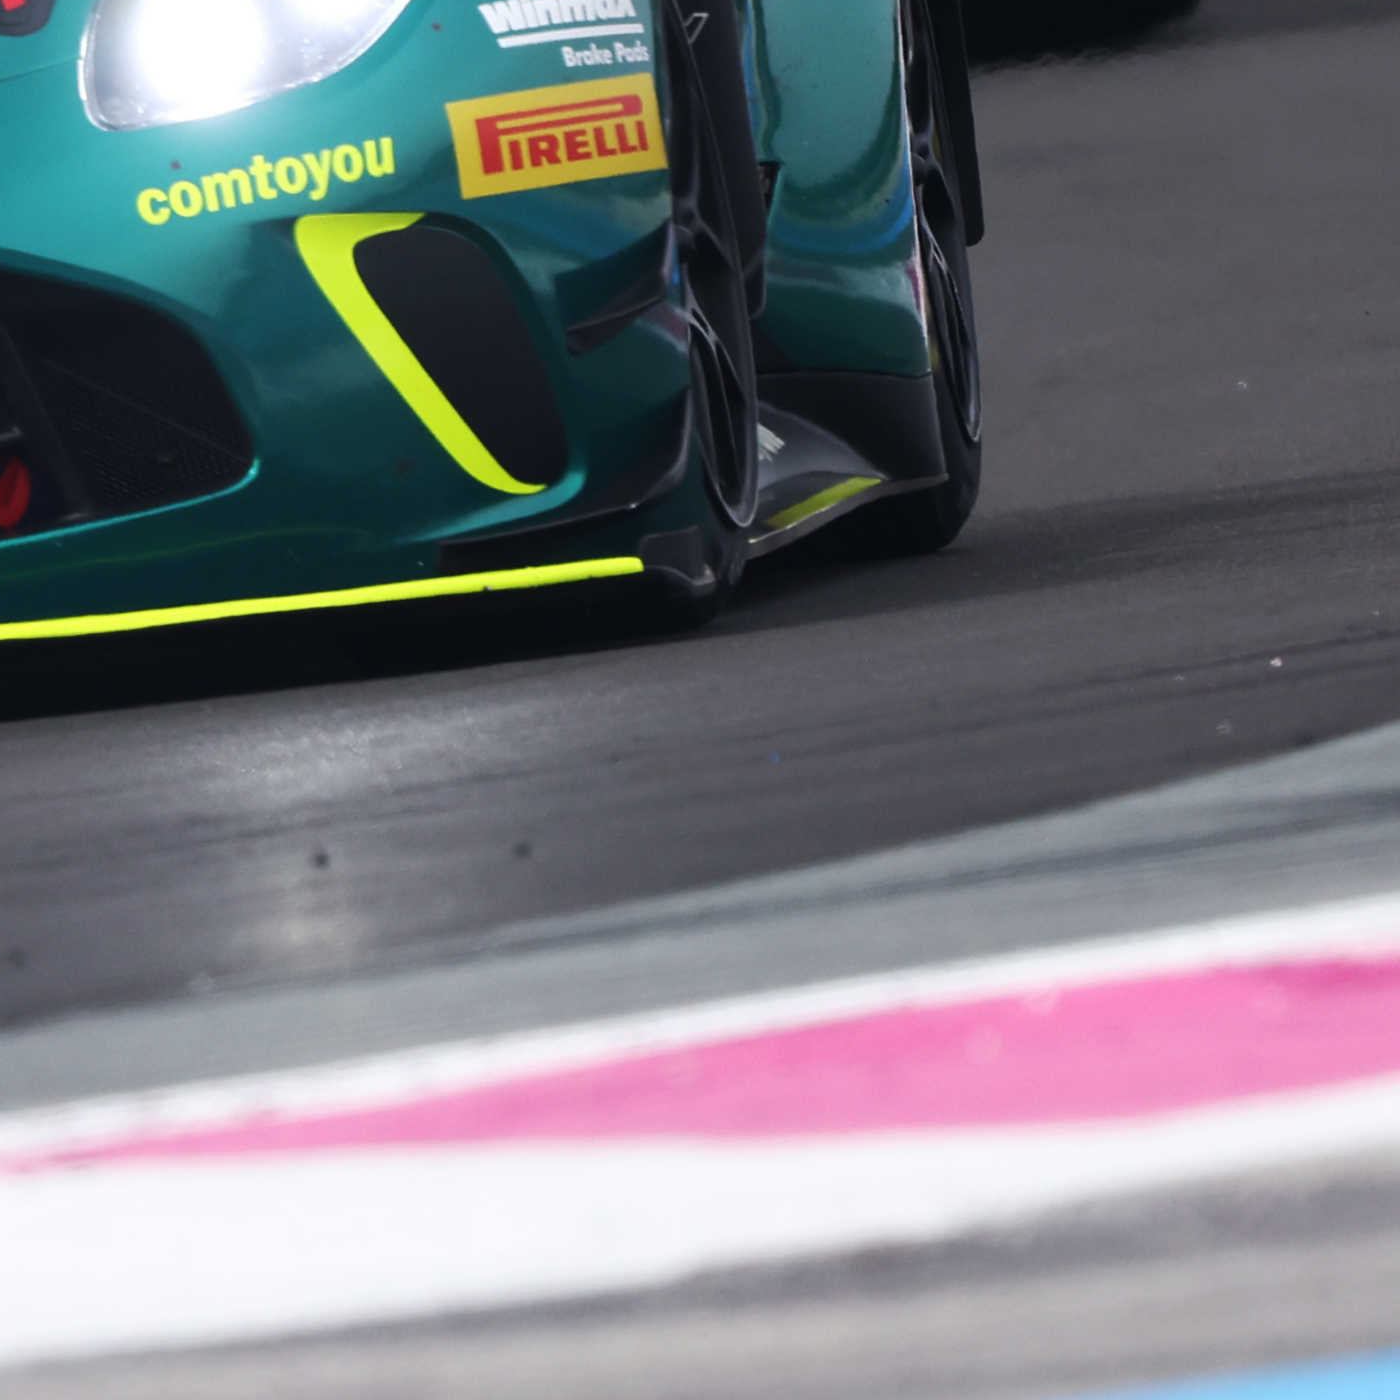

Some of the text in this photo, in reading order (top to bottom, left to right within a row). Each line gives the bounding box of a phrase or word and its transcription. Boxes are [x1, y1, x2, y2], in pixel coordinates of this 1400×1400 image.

[560, 39, 650, 68] Brake Pads
[475, 93, 650, 176] PIRELLI
[136, 136, 395, 226] comtoyou
